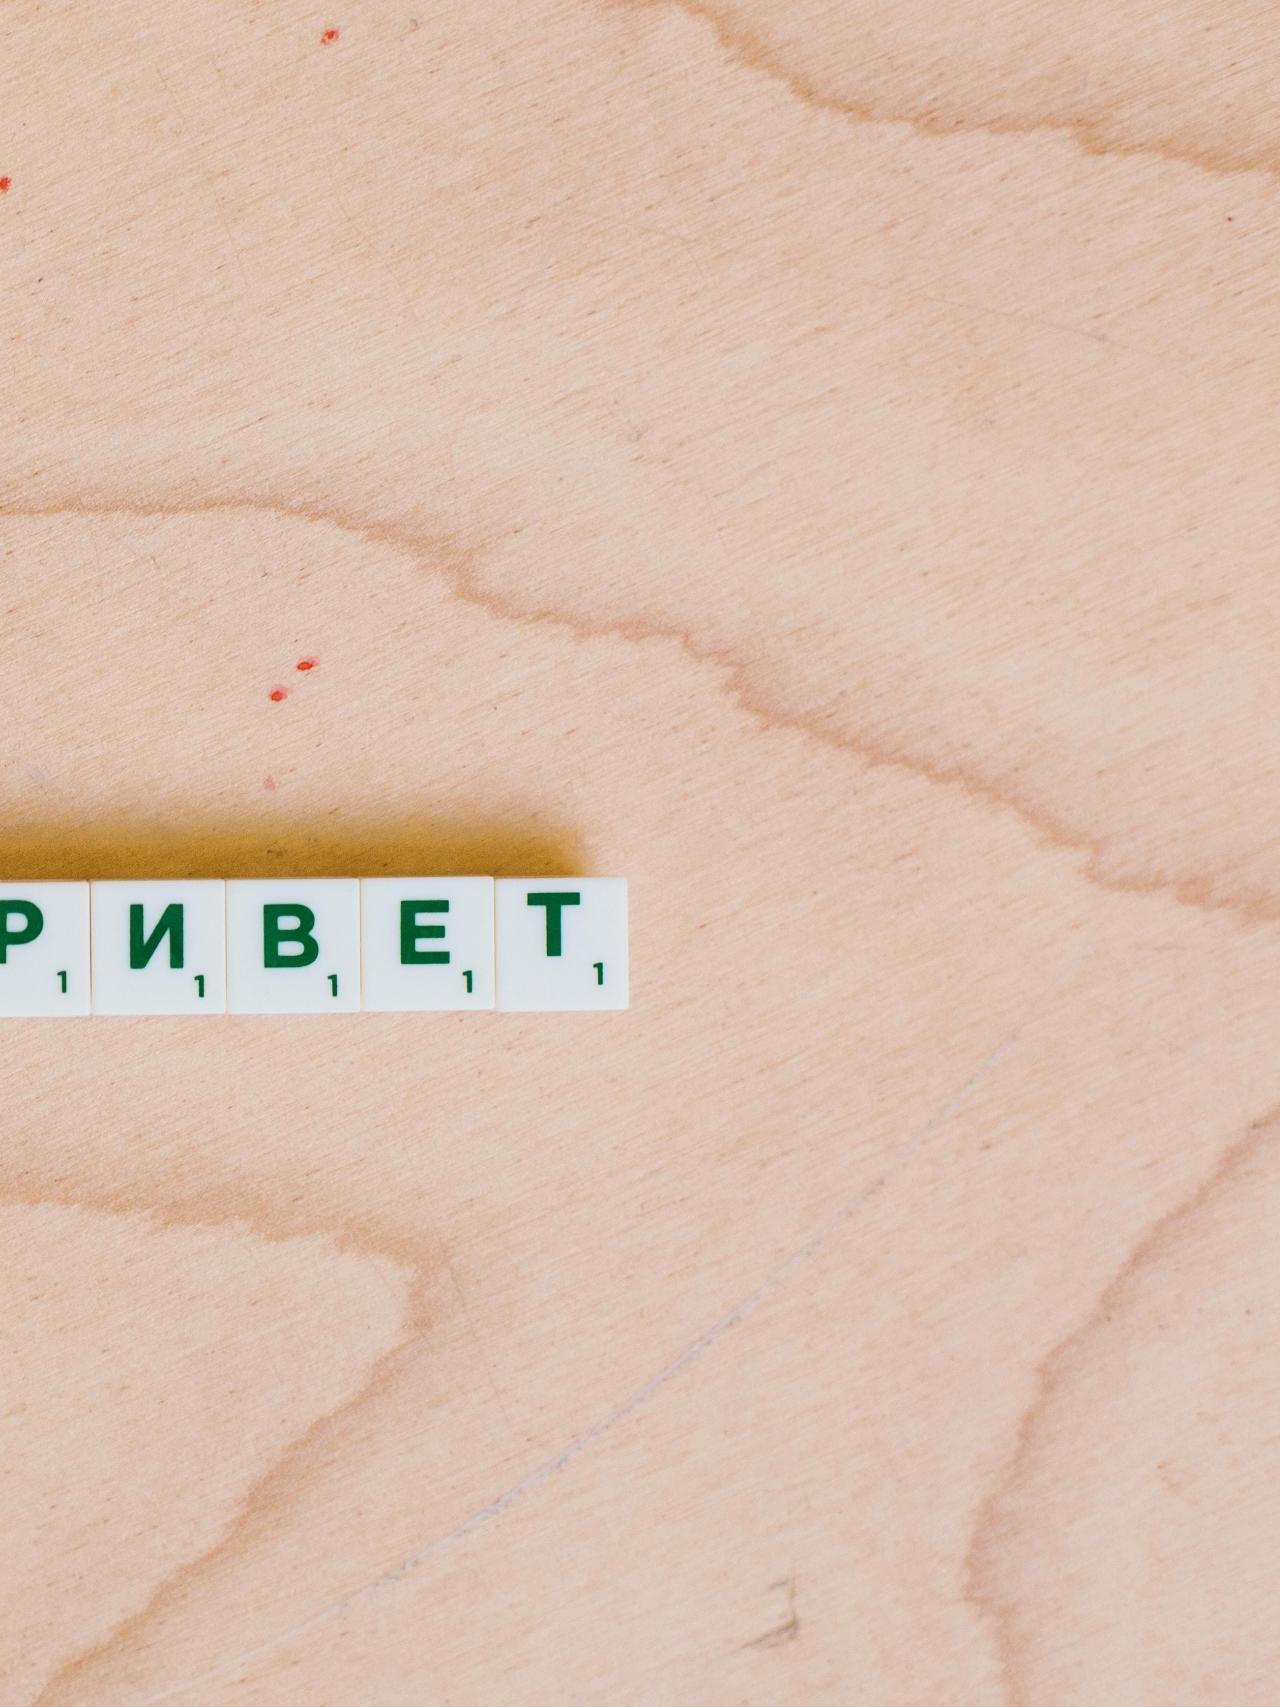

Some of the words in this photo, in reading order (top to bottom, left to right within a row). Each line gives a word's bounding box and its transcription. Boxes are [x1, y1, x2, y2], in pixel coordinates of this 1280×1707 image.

[56, 970, 69, 994] 1
[326, 973, 339, 998] 1
[462, 969, 474, 994] 1
[592, 961, 605, 986] 1
[193, 974, 206, 999] 1
